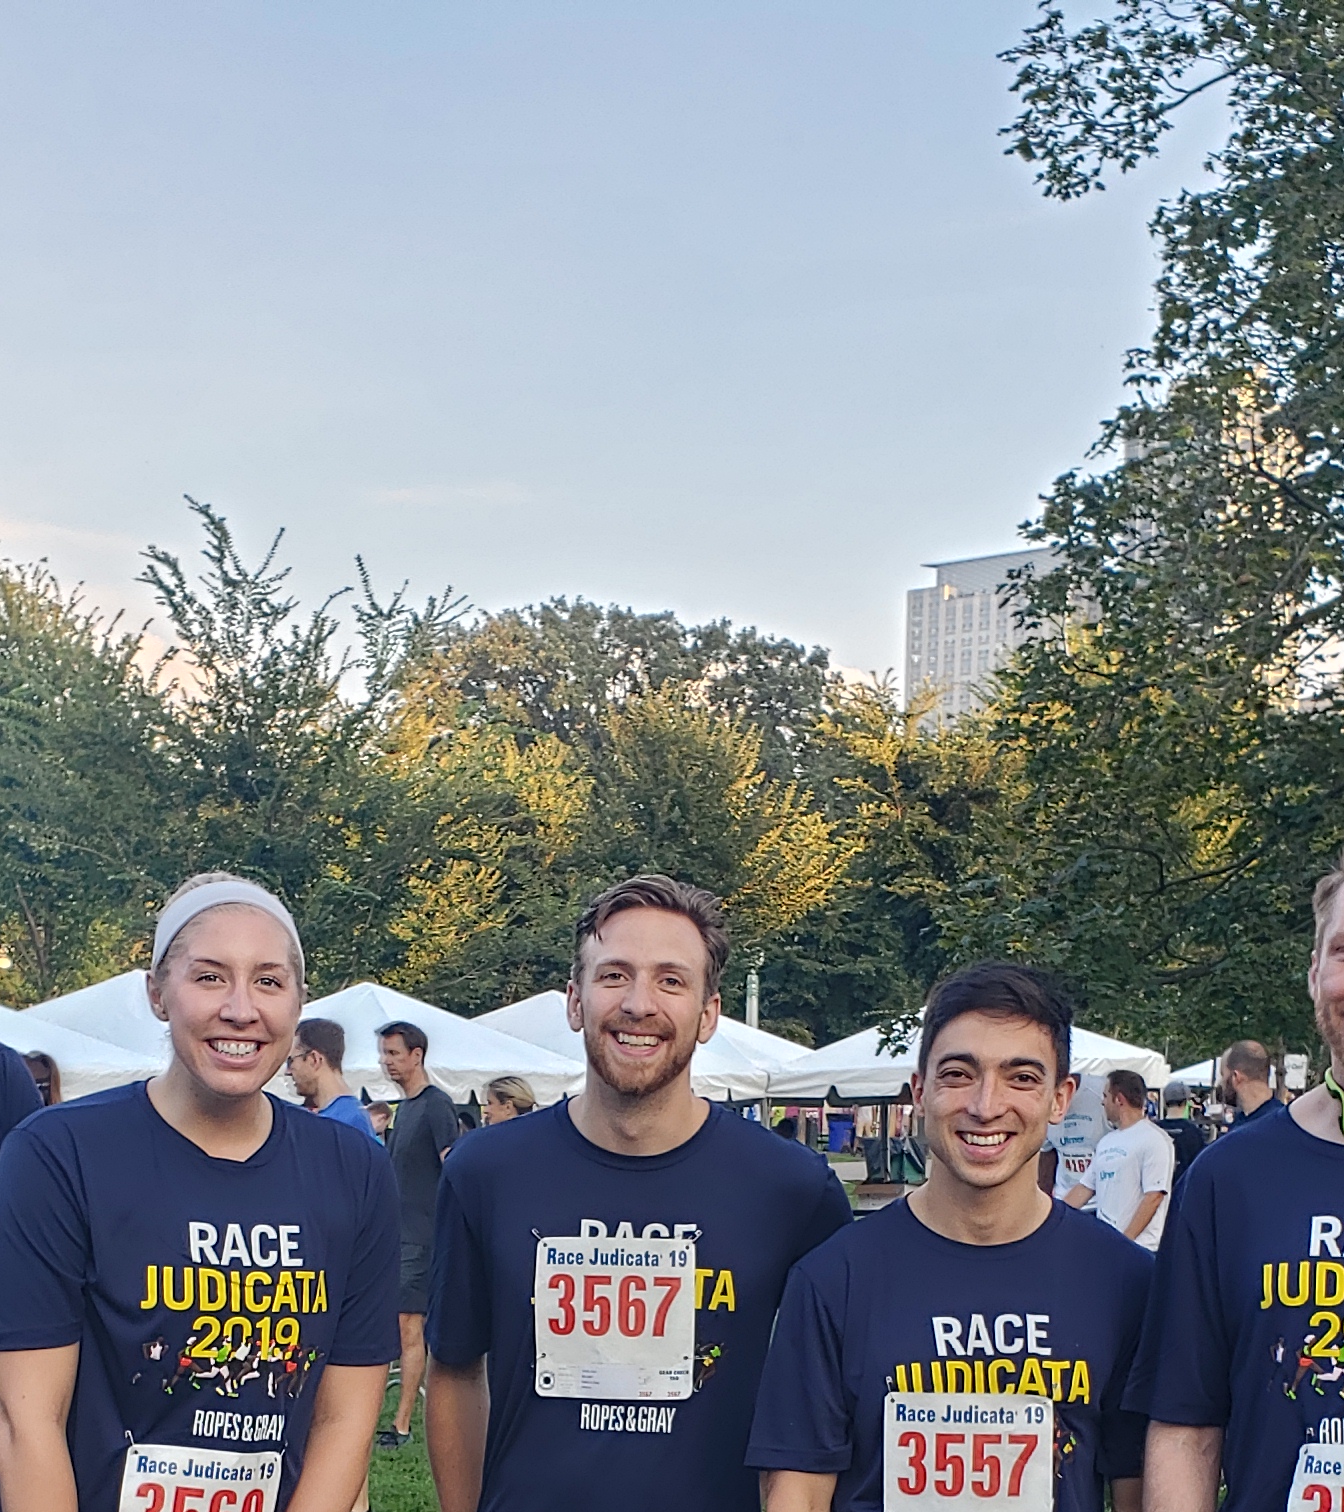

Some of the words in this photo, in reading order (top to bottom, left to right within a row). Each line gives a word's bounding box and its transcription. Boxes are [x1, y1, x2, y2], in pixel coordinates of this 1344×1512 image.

[188, 1221, 304, 1267] RACE
[547, 1248, 584, 1266] Race
[140, 1265, 328, 1314] JUDICATA
[548, 1274, 682, 1338] 3567
[190, 1316, 300, 1361] 2019
[931, 1313, 1052, 1356] RACE
[895, 1357, 1090, 1404] JUDICATA
[896, 1404, 936, 1422] Race
[136, 1455, 177, 1475] Race
[897, 1431, 1039, 1497] 3557
[1304, 1455, 1341, 1475] Race
